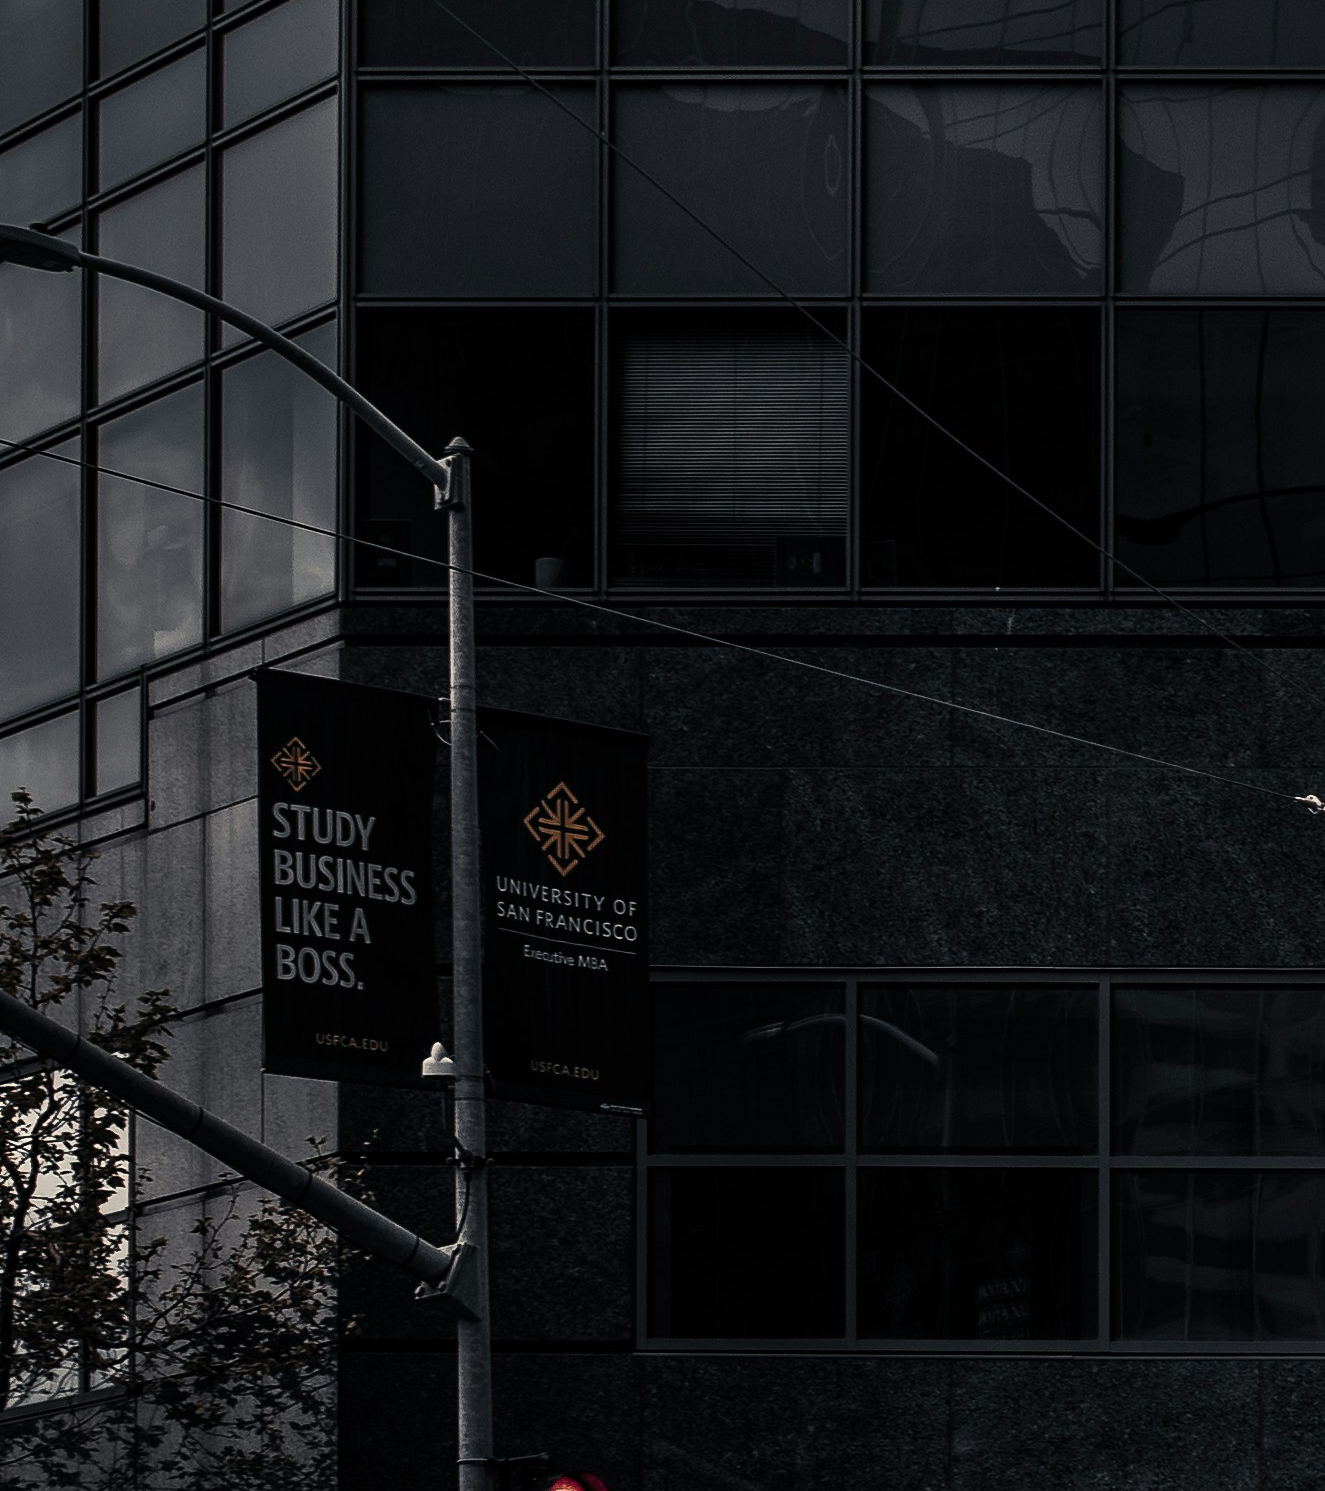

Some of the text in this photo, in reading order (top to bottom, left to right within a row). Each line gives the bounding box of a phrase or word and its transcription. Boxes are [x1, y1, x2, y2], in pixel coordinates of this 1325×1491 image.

[271, 801, 377, 852] STUDY
[272, 848, 419, 907] BUSINESS
[495, 875, 638, 917] UNIVERSITY OF
[274, 895, 373, 945] LIKE A
[496, 900, 638, 942] SAN FRANCISCO
[275, 942, 366, 991] BOSS.
[522, 943, 609, 972] Executive MBA
[315, 1032, 389, 1052] USFCA.EDU
[529, 1058, 601, 1081] USFCA.EDU
